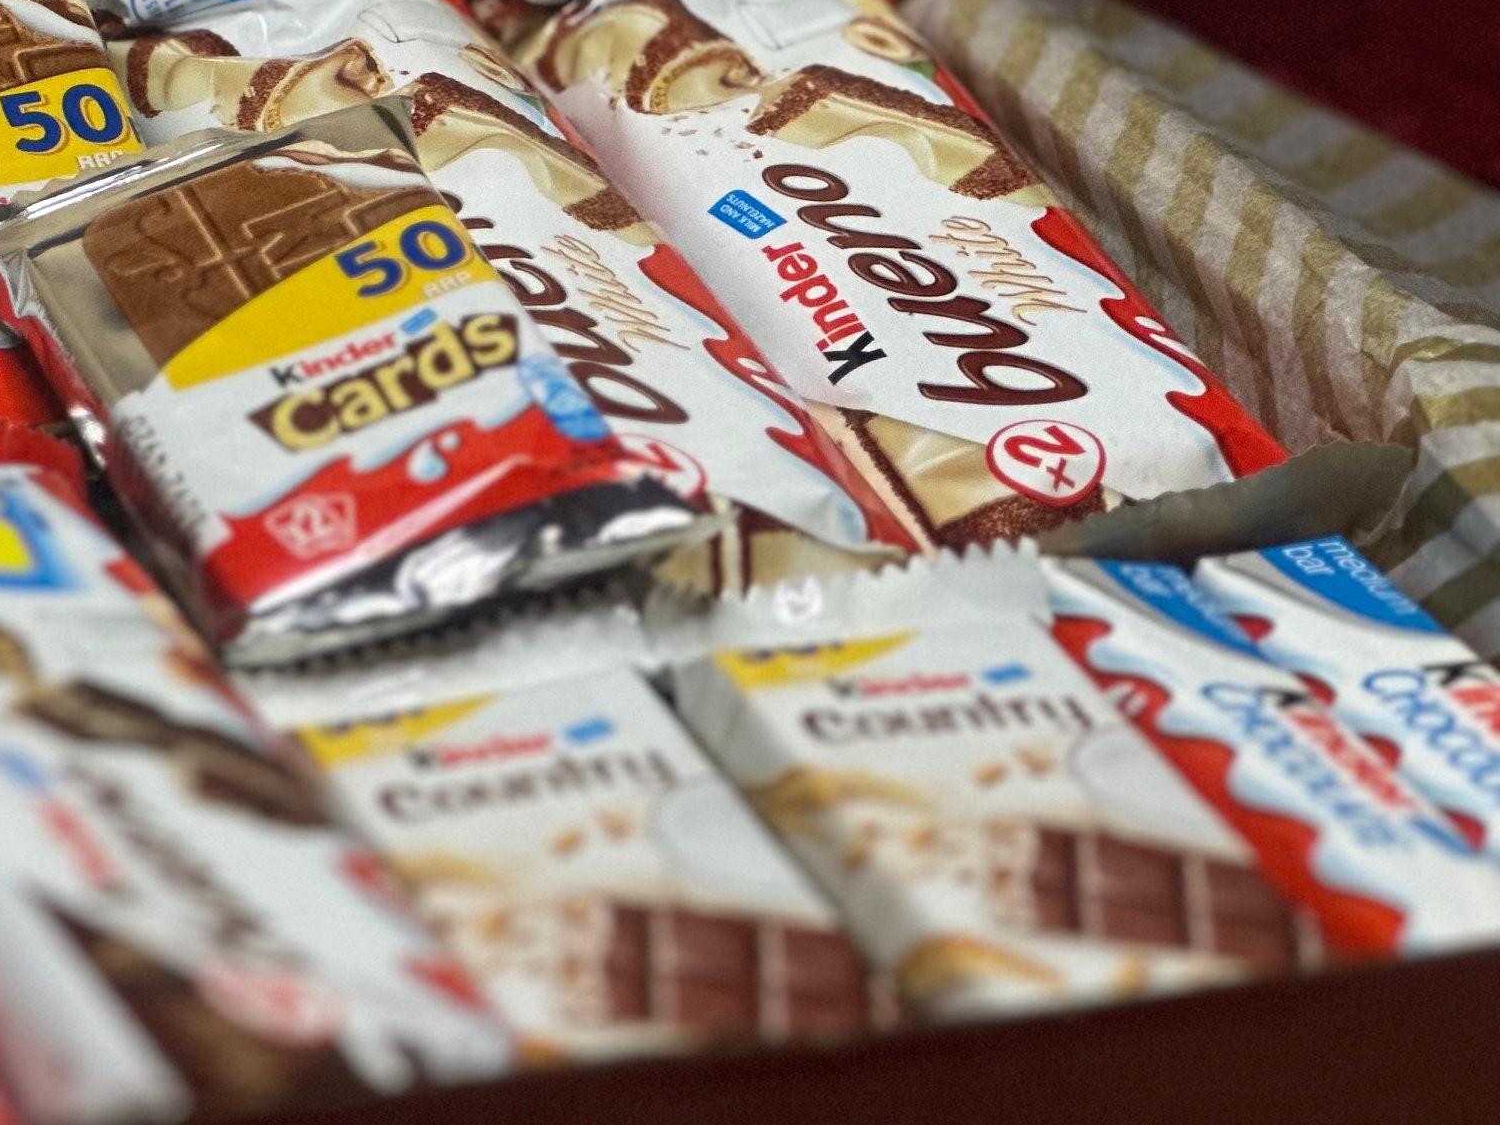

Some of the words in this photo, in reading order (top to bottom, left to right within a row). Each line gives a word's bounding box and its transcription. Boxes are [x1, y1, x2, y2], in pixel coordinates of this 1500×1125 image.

[0, 83, 128, 155] 50
[718, 203, 742, 220] AND
[333, 219, 475, 300] 50
[761, 162, 1090, 407] bueno
[930, 214, 1089, 326] White
[1281, 544, 1336, 576] bar
[1317, 539, 1419, 615] medium
